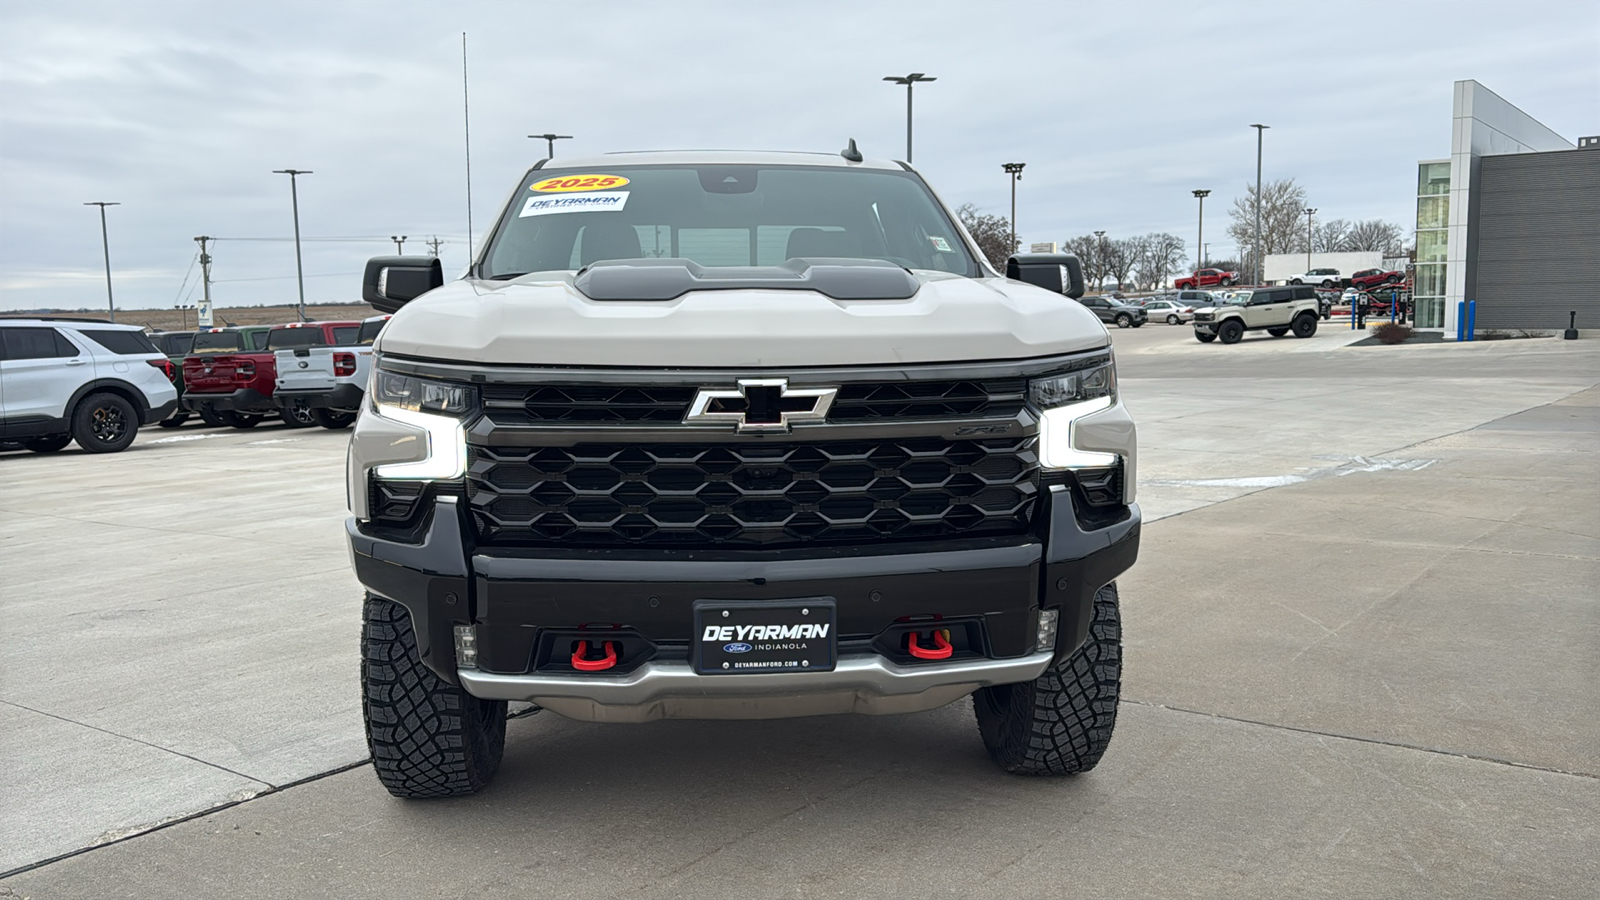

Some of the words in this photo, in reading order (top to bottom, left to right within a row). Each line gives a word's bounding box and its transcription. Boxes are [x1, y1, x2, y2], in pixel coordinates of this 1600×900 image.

[540, 178, 619, 190] 2025
[530, 197, 621, 208] DEYARMAN
[702, 624, 830, 641] DEYARMAN
